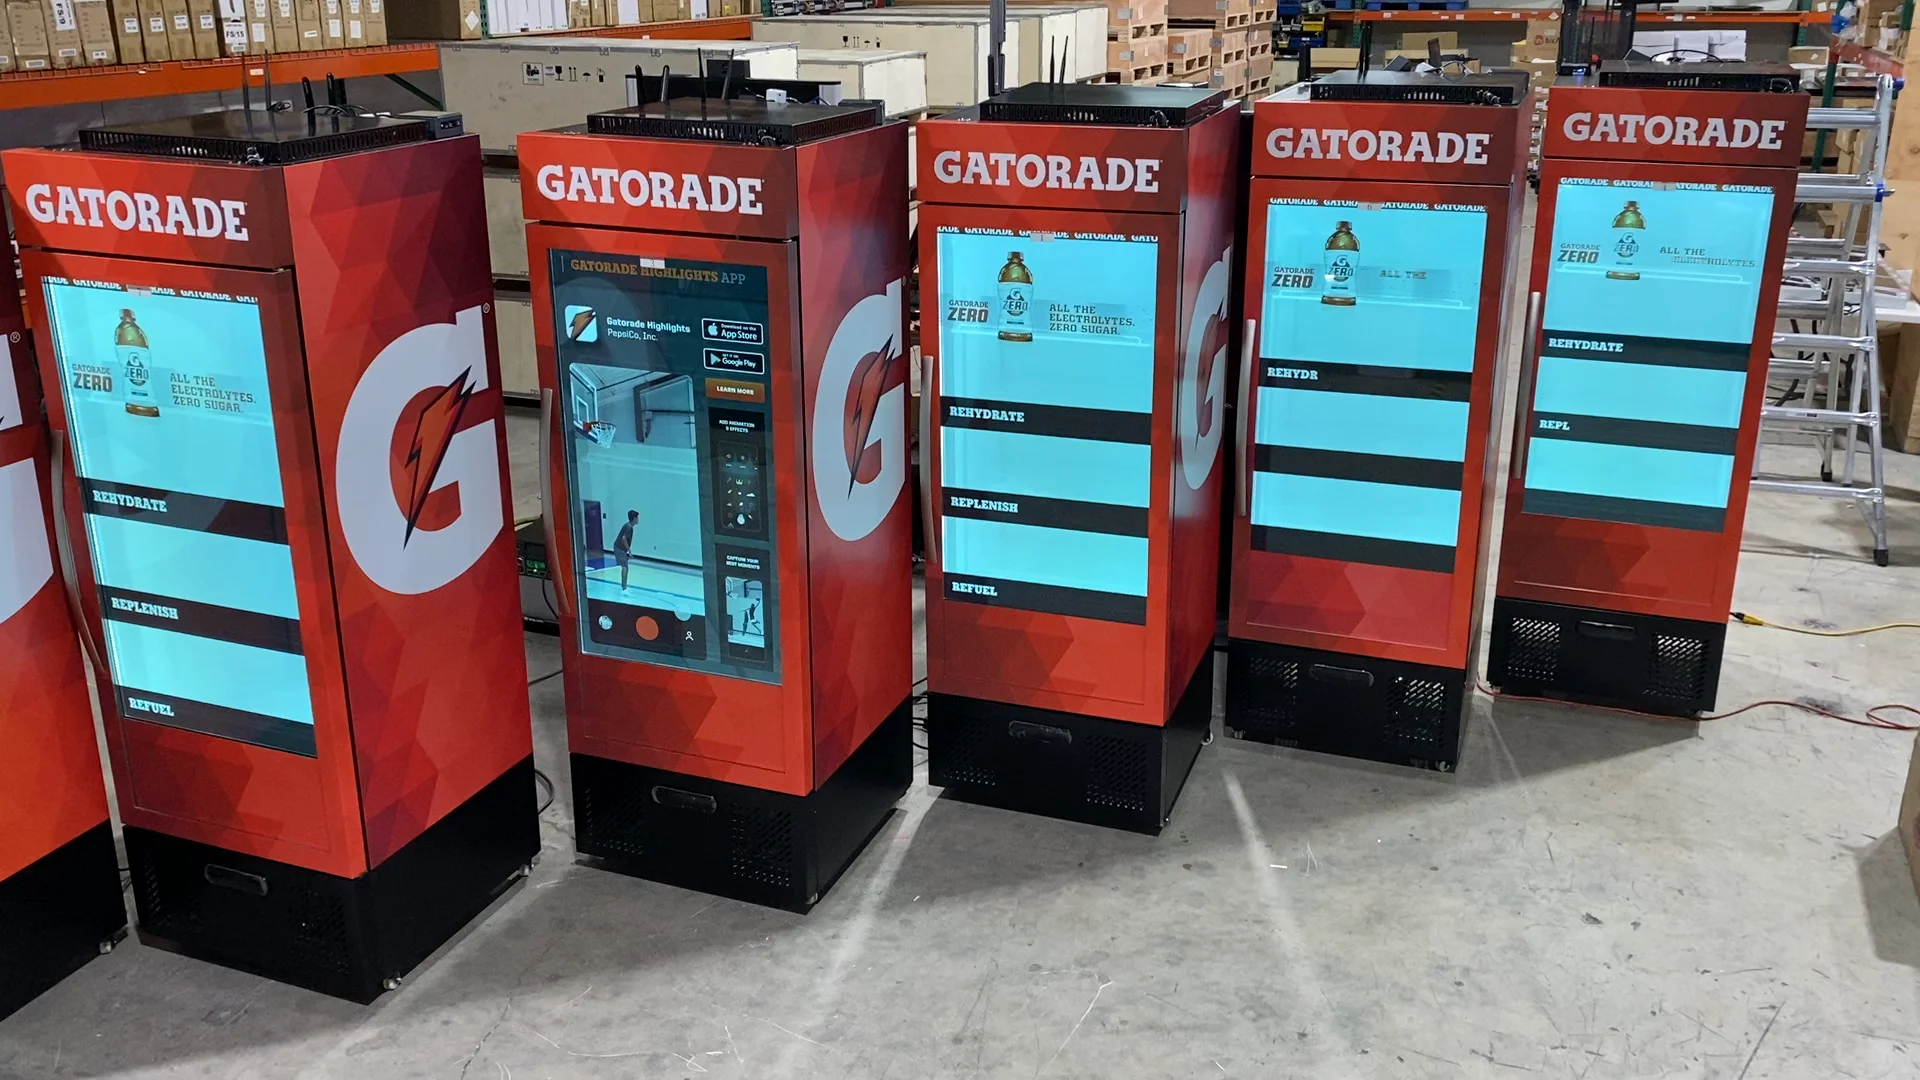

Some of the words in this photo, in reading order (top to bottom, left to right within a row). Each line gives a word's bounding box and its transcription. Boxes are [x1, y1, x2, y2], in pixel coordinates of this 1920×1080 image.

[1563, 112, 1786, 150] GATORADE
[1266, 127, 1490, 165] GATORADE
[934, 150, 1159, 193] GATORADE
[537, 164, 763, 215] GATORADE
[1560, 177, 1609, 186] GATORADE
[1676, 182, 1718, 191] ATORADE
[1721, 184, 1774, 193] GATORADE
[25, 182, 249, 242] GATORADE
[1560, 243, 1600, 251] GATORADE
[1660, 247, 1680, 255] ALL
[1684, 248, 1705, 256] THE
[1557, 250, 1600, 263] ZERO
[570, 259, 637, 276] GATORADE
[640, 266, 719, 283] HIGHLIGHTS
[721, 272, 746, 285] APP
[1274, 266, 1315, 275] GATORADE
[1271, 274, 1314, 289] ZERO
[948, 300, 989, 308] GATORADE
[1003, 300, 1028, 311] ZERO
[1049, 304, 1070, 314] ALL
[1074, 305, 1096, 314] THE
[947, 307, 989, 323] ZERO
[1049, 314, 1135, 327] ELECTROLYTES.
[606, 317, 645, 329] Gatorade
[647, 321, 691, 334] Highlights
[1049, 323, 1077, 333] ZERO
[1081, 324, 1121, 335] SUGAR.
[607, 328, 642, 341] PepsiCo,
[643, 332, 659, 342] Inc.
[721, 329, 737, 339] App
[737, 331, 758, 341] Store
[1548, 338, 1624, 353] REHYDRATE
[72, 364, 111, 375] GATORADE
[722, 358, 743, 367] Google
[743, 359, 757, 369] Play
[124, 367, 149, 380] ZERO
[170, 373, 191, 384] ALL
[194, 375, 216, 387] THE
[1267, 367, 1318, 380] REHYDR
[73, 372, 113, 393] ZERO
[171, 384, 257, 404] ELECTROLYTES.
[737, 387, 755, 396] MORE
[173, 396, 201, 408] ZERO
[204, 400, 244, 413] SUGAR.
[812, 275, 905, 541] G
[950, 406, 1025, 422] REHYDRATE
[1539, 419, 1570, 431] REPL
[335, 305, 504, 595] G
[92, 490, 167, 513] REHYDRATE
[951, 497, 1018, 513] REPLENISH
[737, 562, 760, 570] MOMENTS
[952, 581, 998, 596] REFUEL
[111, 597, 179, 620] REPLENISH
[128, 697, 175, 717] REFUEL
